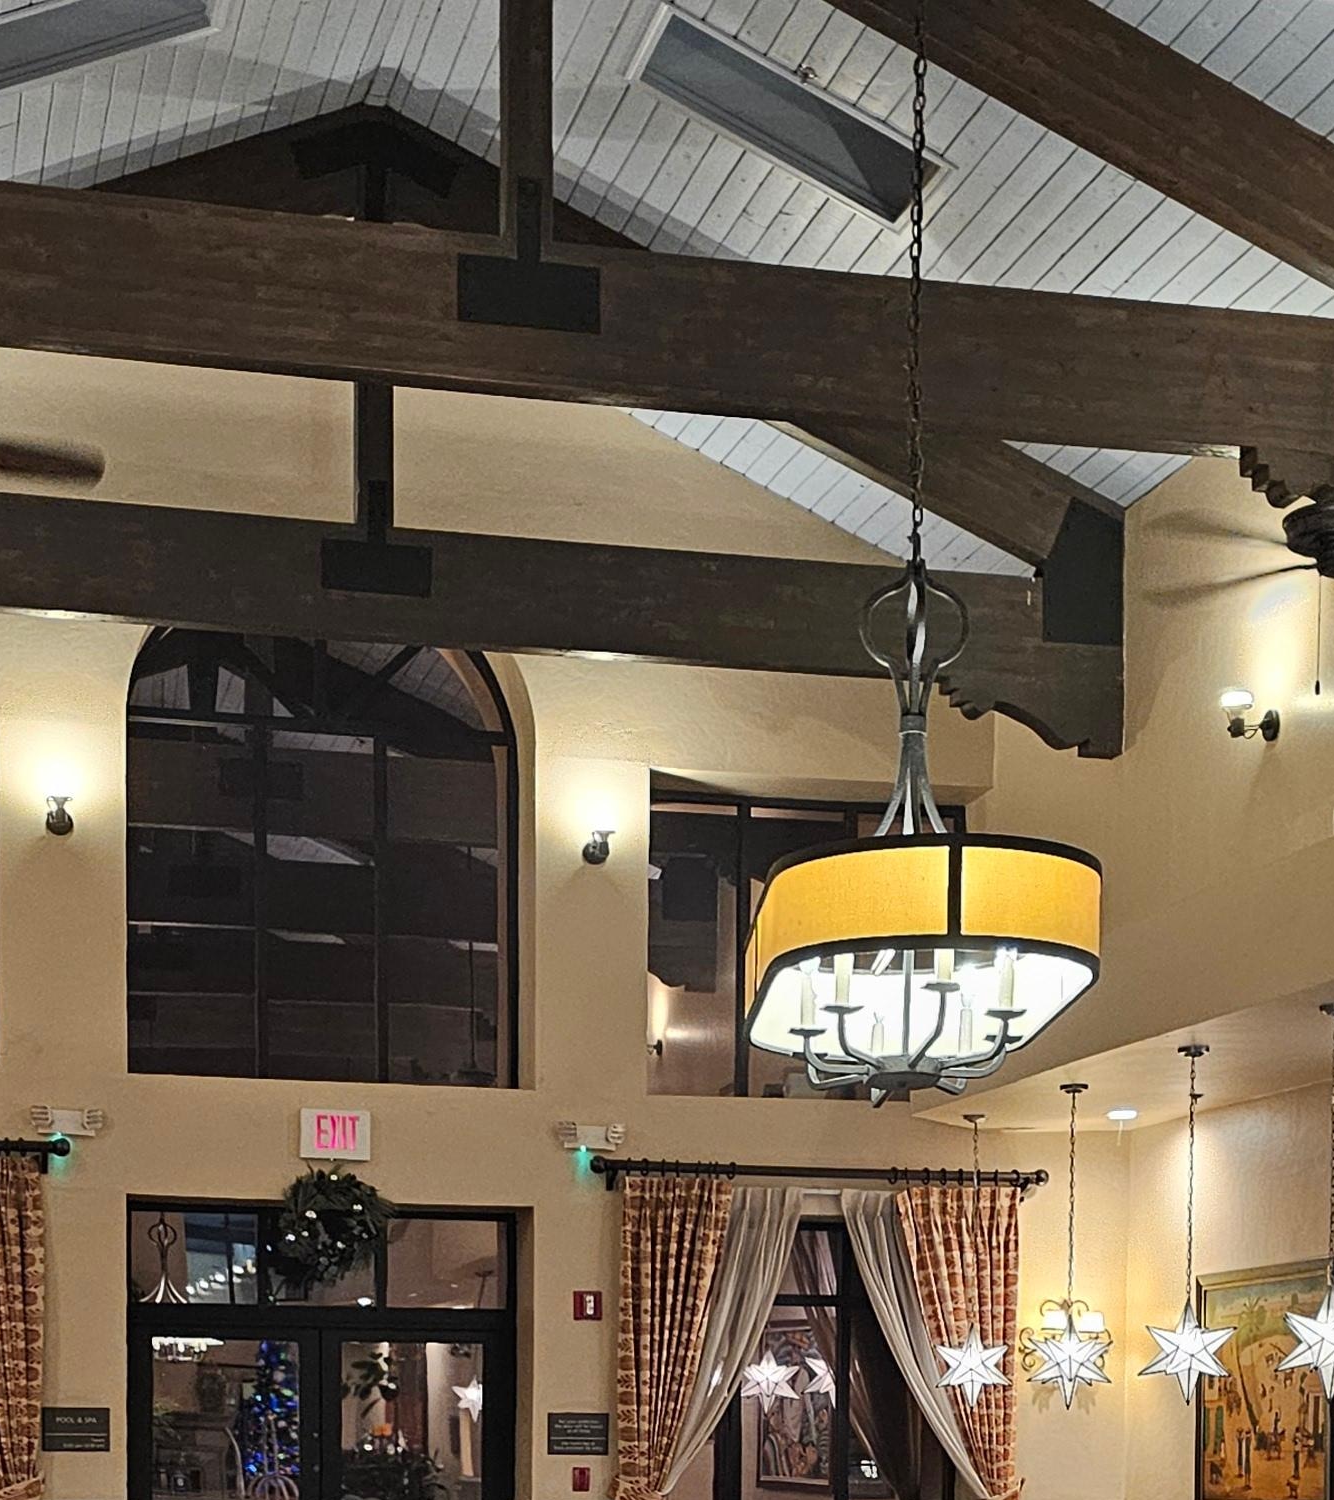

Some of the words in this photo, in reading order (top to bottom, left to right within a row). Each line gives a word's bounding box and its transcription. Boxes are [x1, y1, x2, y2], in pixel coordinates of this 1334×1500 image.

[315, 1114, 360, 1150] EXIT
[56, 1416, 75, 1424] POOL
[84, 1416, 98, 1424] SPA
